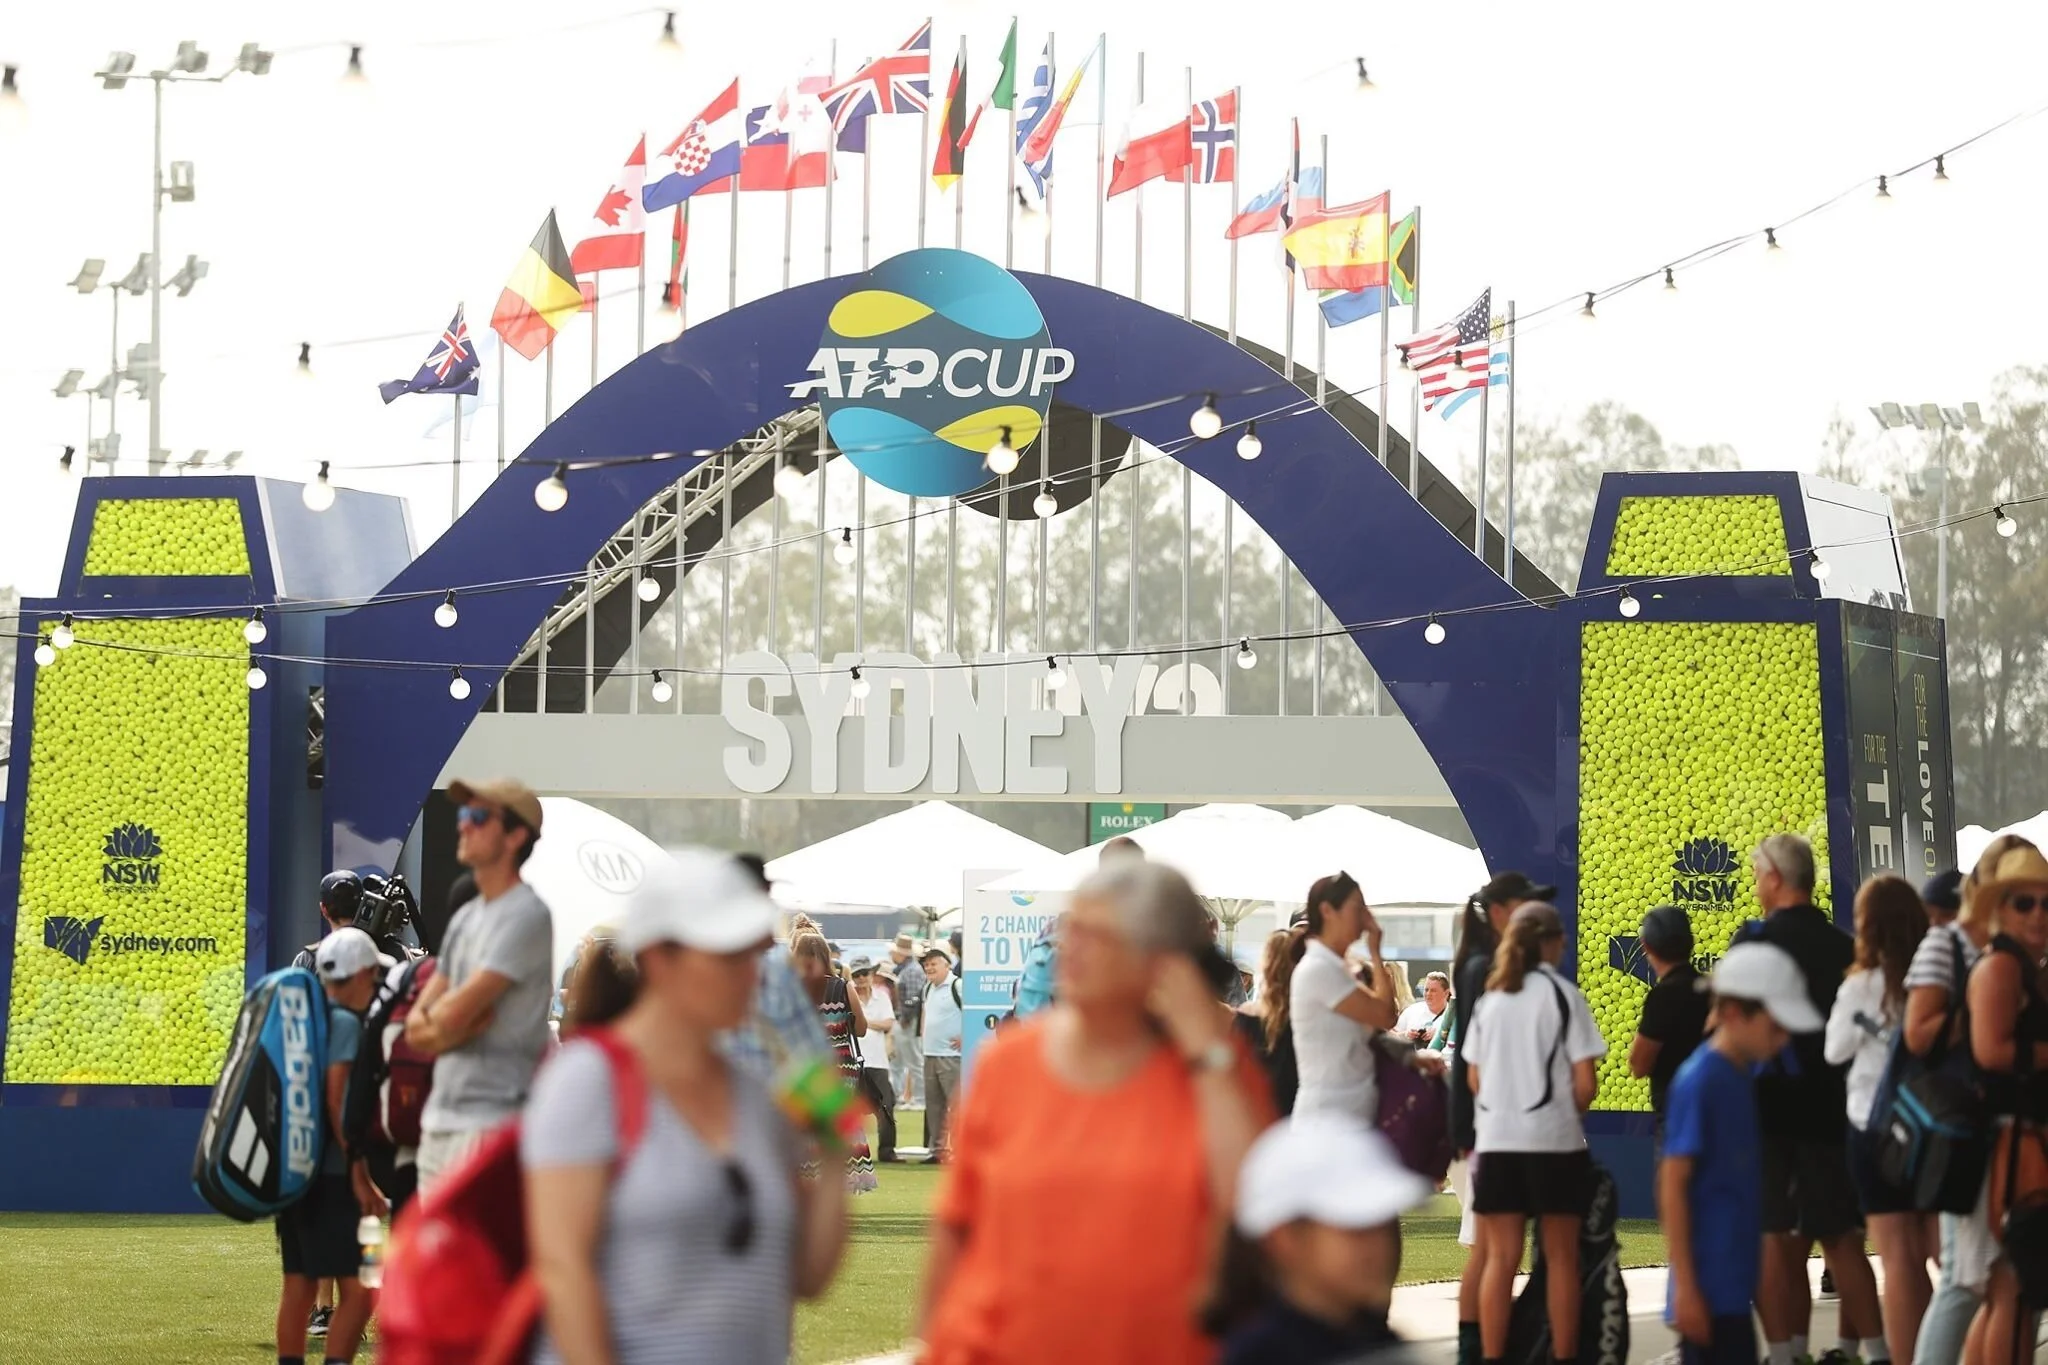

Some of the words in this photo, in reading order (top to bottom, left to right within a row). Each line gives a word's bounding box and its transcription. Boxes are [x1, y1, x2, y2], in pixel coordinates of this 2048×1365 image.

[942, 347, 1076, 398] CUP
[1913, 673, 1927, 705] FOR
[721, 650, 1146, 794] SYDNEY
[1915, 705, 1928, 737] THE
[1863, 733, 1876, 764] FOR
[1876, 734, 1888, 765] THE
[1917, 740, 1935, 843] LOVE
[1100, 815, 1155, 828] ROLEX
[1866, 768, 1895, 879] TE
[102, 863, 160, 885] NSW
[1673, 879, 1738, 902] NSW
[980, 915, 990, 934] 2
[100, 932, 219, 956] sydney.com
[980, 936, 1010, 965] TO
[278, 984, 316, 1179] Babolat
